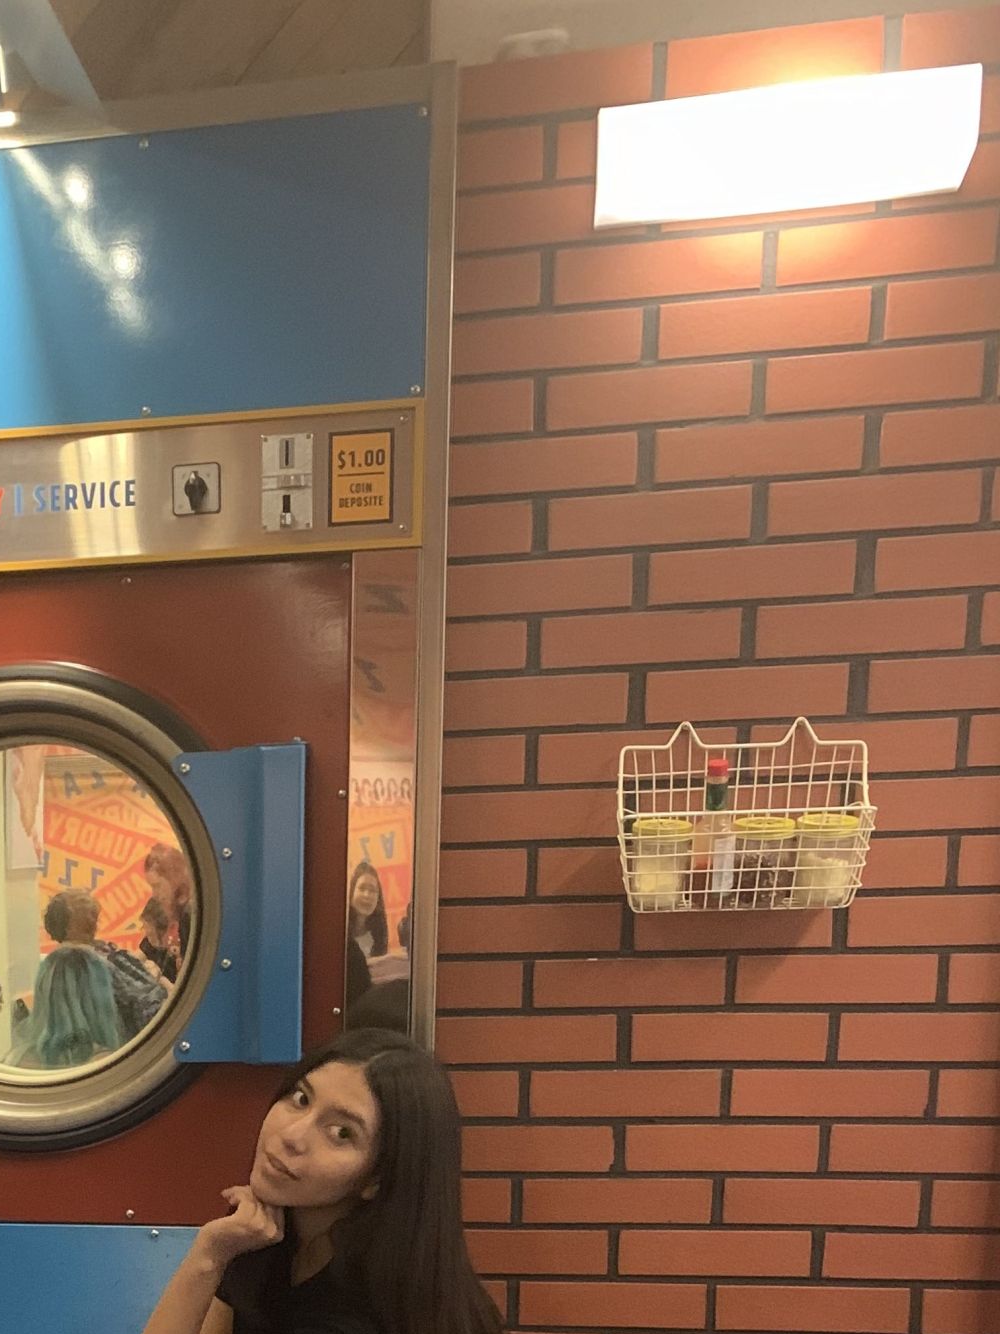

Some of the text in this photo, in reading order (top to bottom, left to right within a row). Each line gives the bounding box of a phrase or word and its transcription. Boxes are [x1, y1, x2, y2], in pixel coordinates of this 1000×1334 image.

[338, 449, 386, 469] $1.00
[34, 480, 137, 514] SERVICE
[350, 482, 372, 494] COIN
